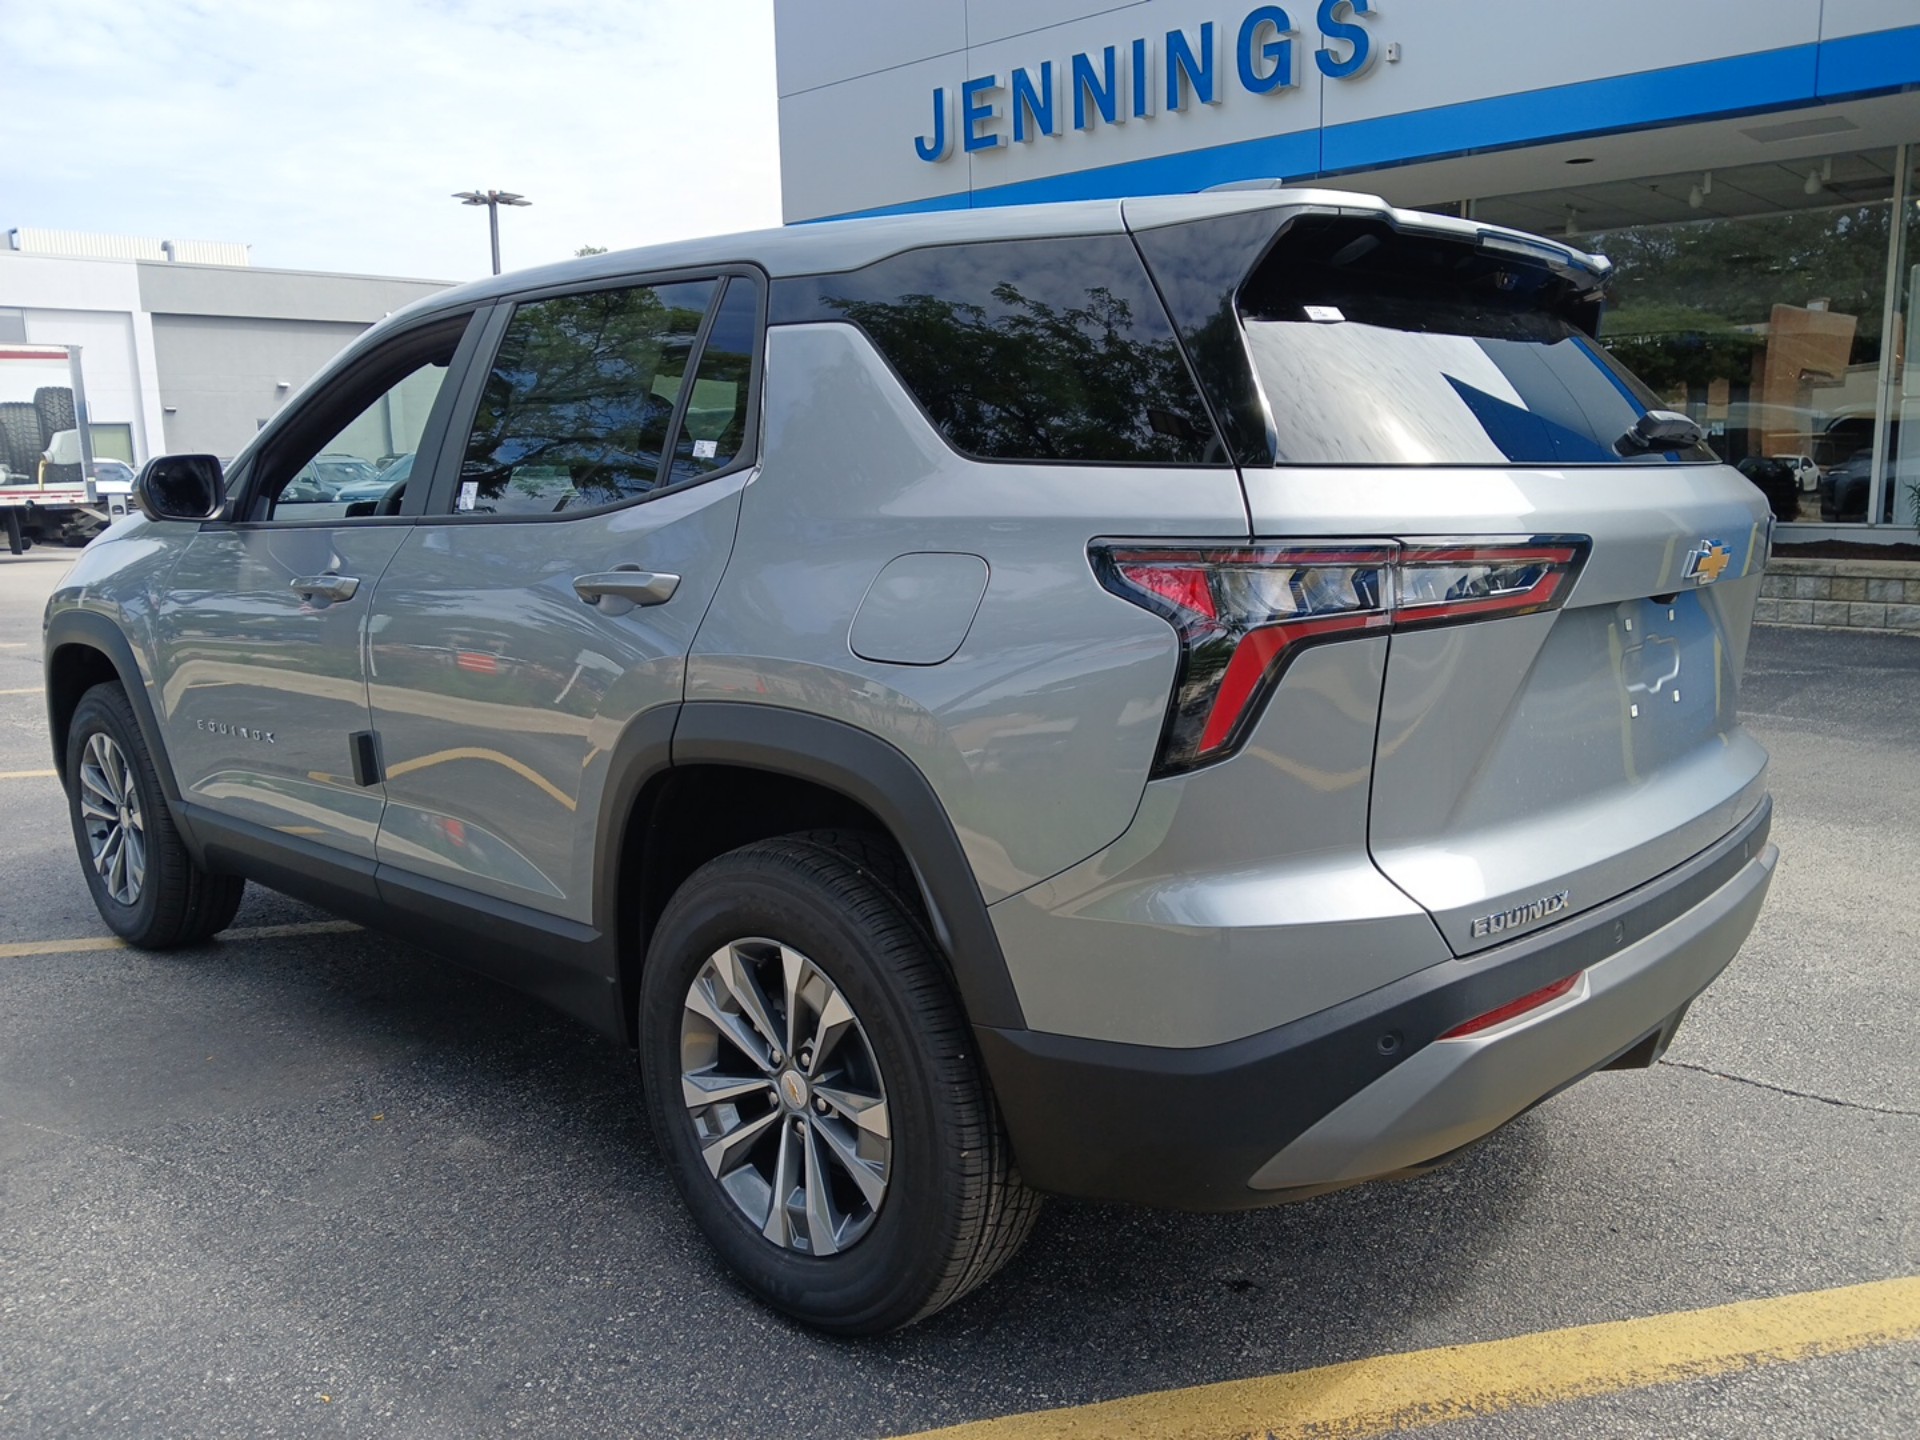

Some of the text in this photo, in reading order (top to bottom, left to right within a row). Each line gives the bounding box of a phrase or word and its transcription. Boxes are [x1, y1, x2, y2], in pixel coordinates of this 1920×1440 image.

[915, 0, 1375, 162] JENNINGS
[196, 719, 275, 744] EQUINOX
[1471, 889, 1569, 938] EQUINOX
